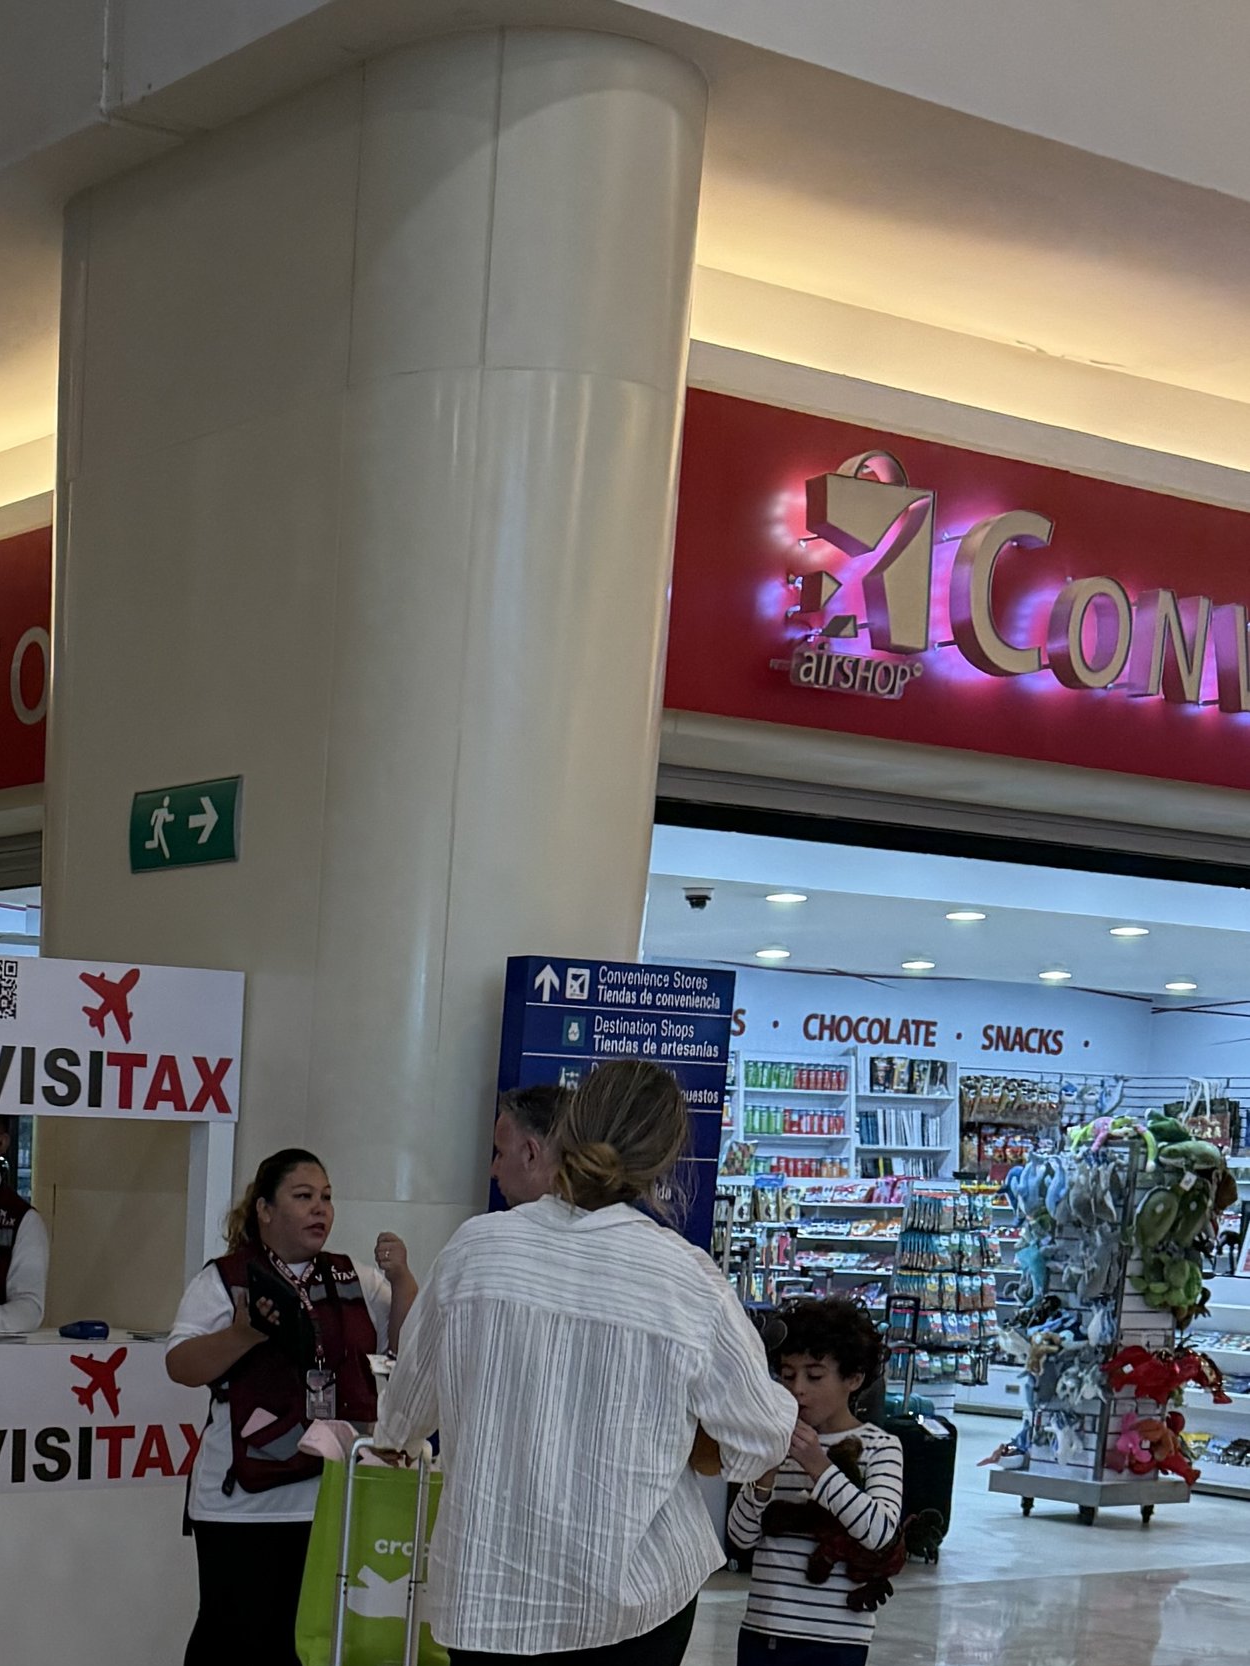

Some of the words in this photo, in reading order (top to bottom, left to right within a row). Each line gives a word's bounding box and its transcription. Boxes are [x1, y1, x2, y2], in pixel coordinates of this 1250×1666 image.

[951, 508, 1250, 715] CON
[598, 965, 670, 987] Convenience
[673, 971, 708, 990] Stores
[597, 985, 637, 1005] Tiendas
[640, 989, 652, 1003] de
[655, 992, 720, 1010] conveniencia
[594, 1015, 656, 1036] Destination
[660, 1019, 694, 1040] Shops
[802, 1012, 938, 1048] CHOCOLATE
[981, 1023, 1065, 1056] SNACKS
[593, 1034, 638, 1054] Tiendas
[643, 1037, 657, 1055] de
[660, 1039, 719, 1058] artesanías
[315, 1270, 357, 1282] VITAX
